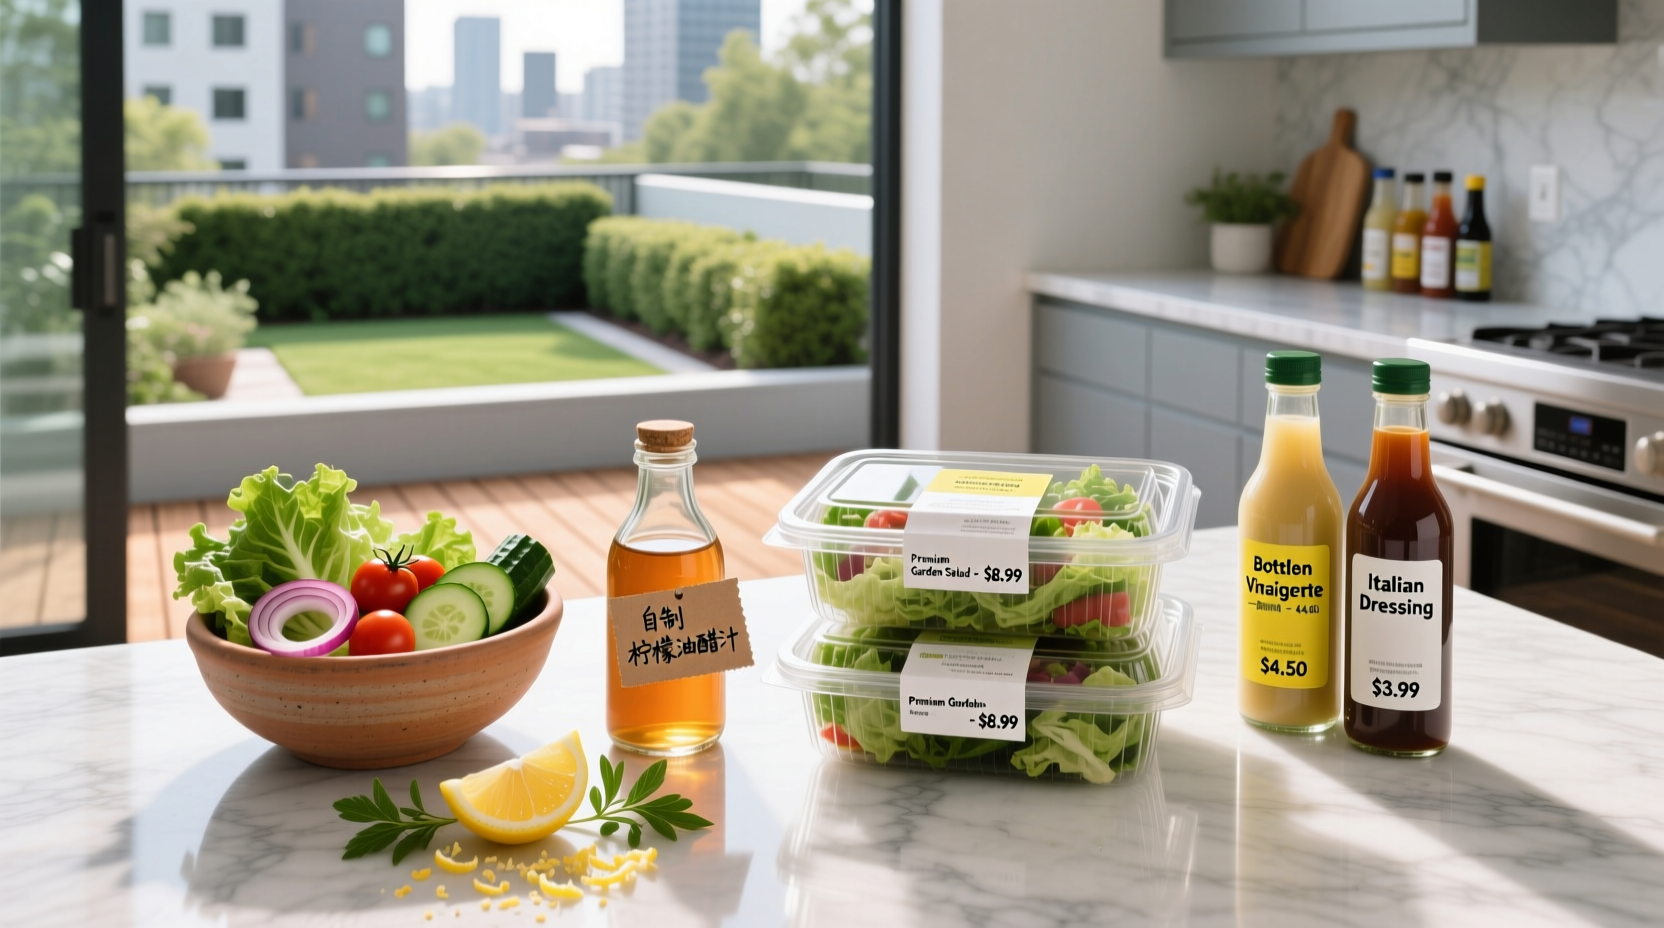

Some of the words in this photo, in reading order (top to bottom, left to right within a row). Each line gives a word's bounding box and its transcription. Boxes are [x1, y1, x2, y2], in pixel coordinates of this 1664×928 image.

[911, 566, 943, 577] Garden
[984, 565, 1023, 583] $8.99
[1254, 555, 1312, 576] Bottlen
[1368, 573, 1424, 593] Italian
[1360, 593, 1434, 620] Dressing
[643, 605, 684, 632] 自制
[628, 626, 739, 667] 柠檬油醋汁
[1261, 656, 1308, 677] $4.50
[1372, 677, 1420, 698] $3.99
[978, 712, 1019, 730] $8.99
